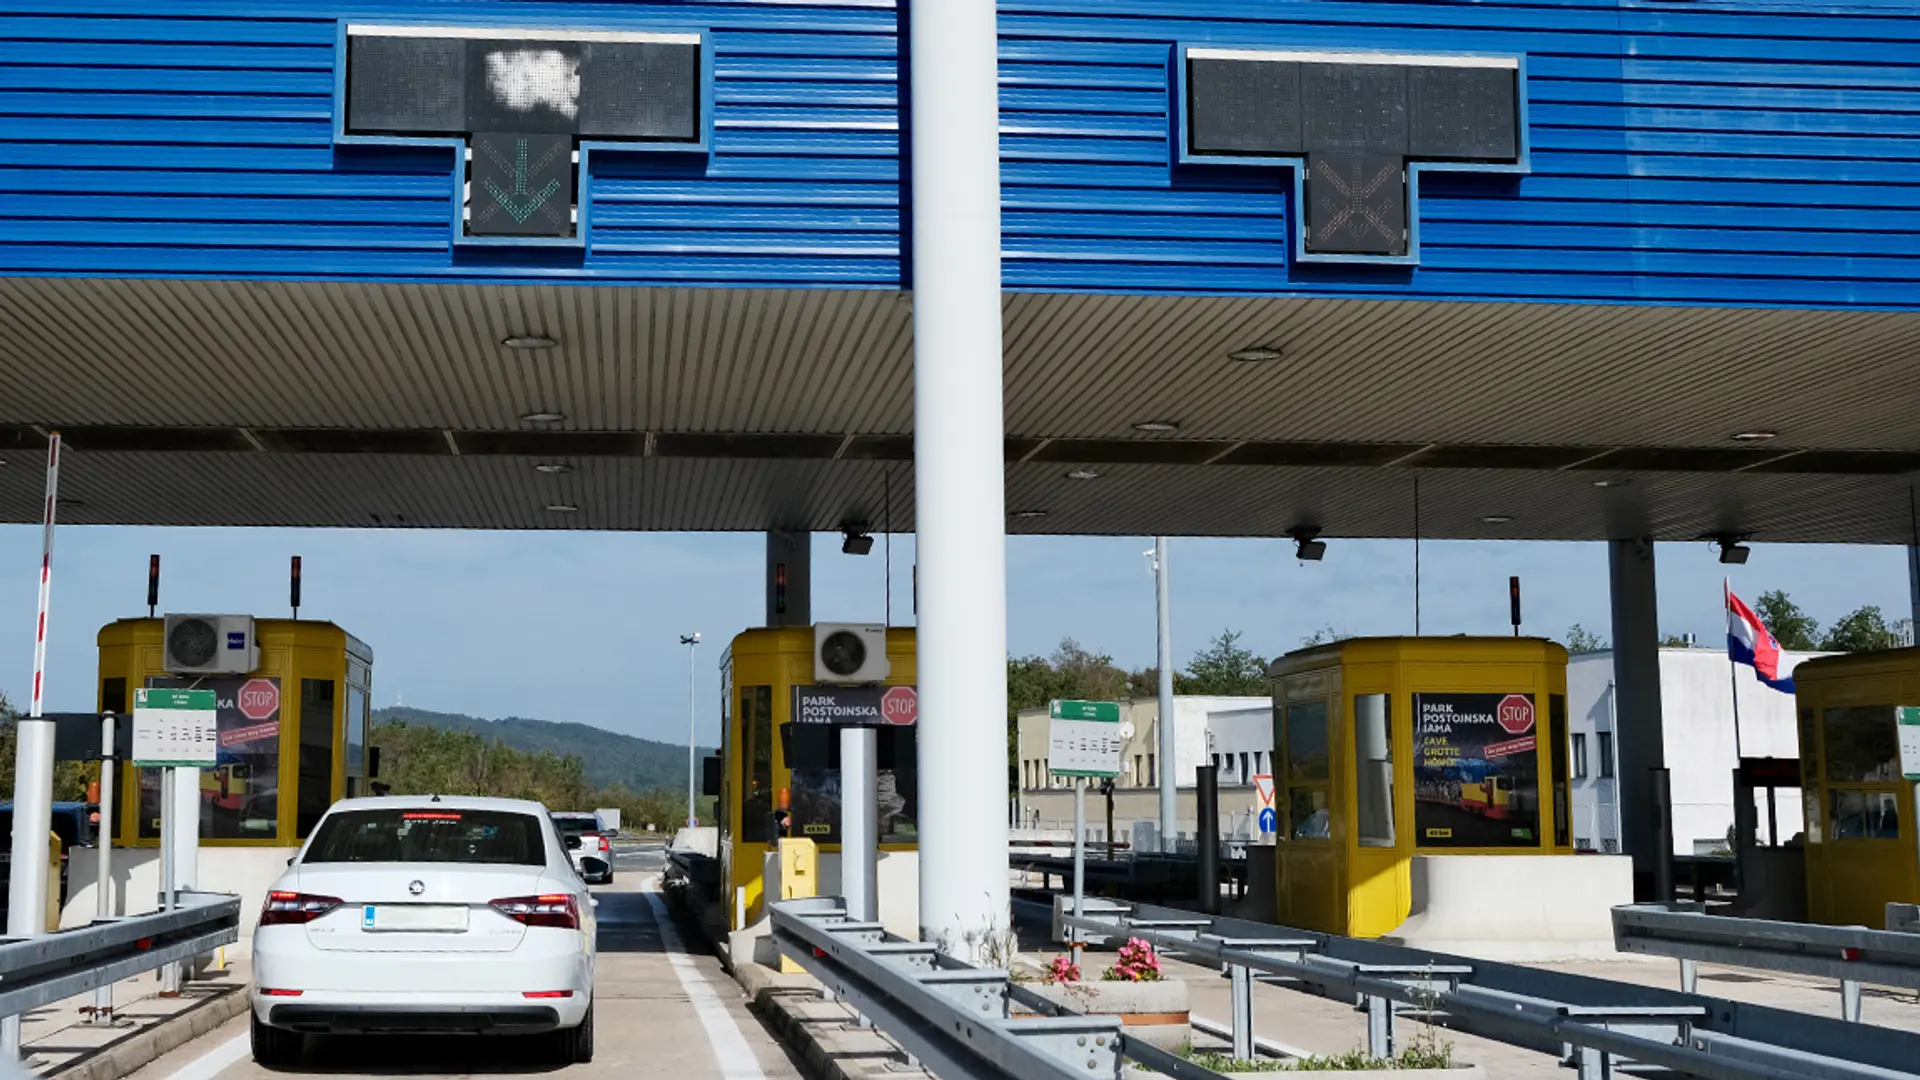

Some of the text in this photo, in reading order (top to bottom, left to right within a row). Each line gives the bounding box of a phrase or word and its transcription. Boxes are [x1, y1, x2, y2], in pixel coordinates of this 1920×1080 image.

[244, 691, 274, 707] STOP
[802, 696, 836, 706] PARK
[802, 706, 878, 716] POSTOJNSKA
[887, 698, 916, 714] STOP
[1422, 703, 1454, 713] PARK
[1502, 706, 1529, 721] STOP
[1424, 736, 1448, 746] CAVE
[1424, 747, 1461, 756] GROTTE
